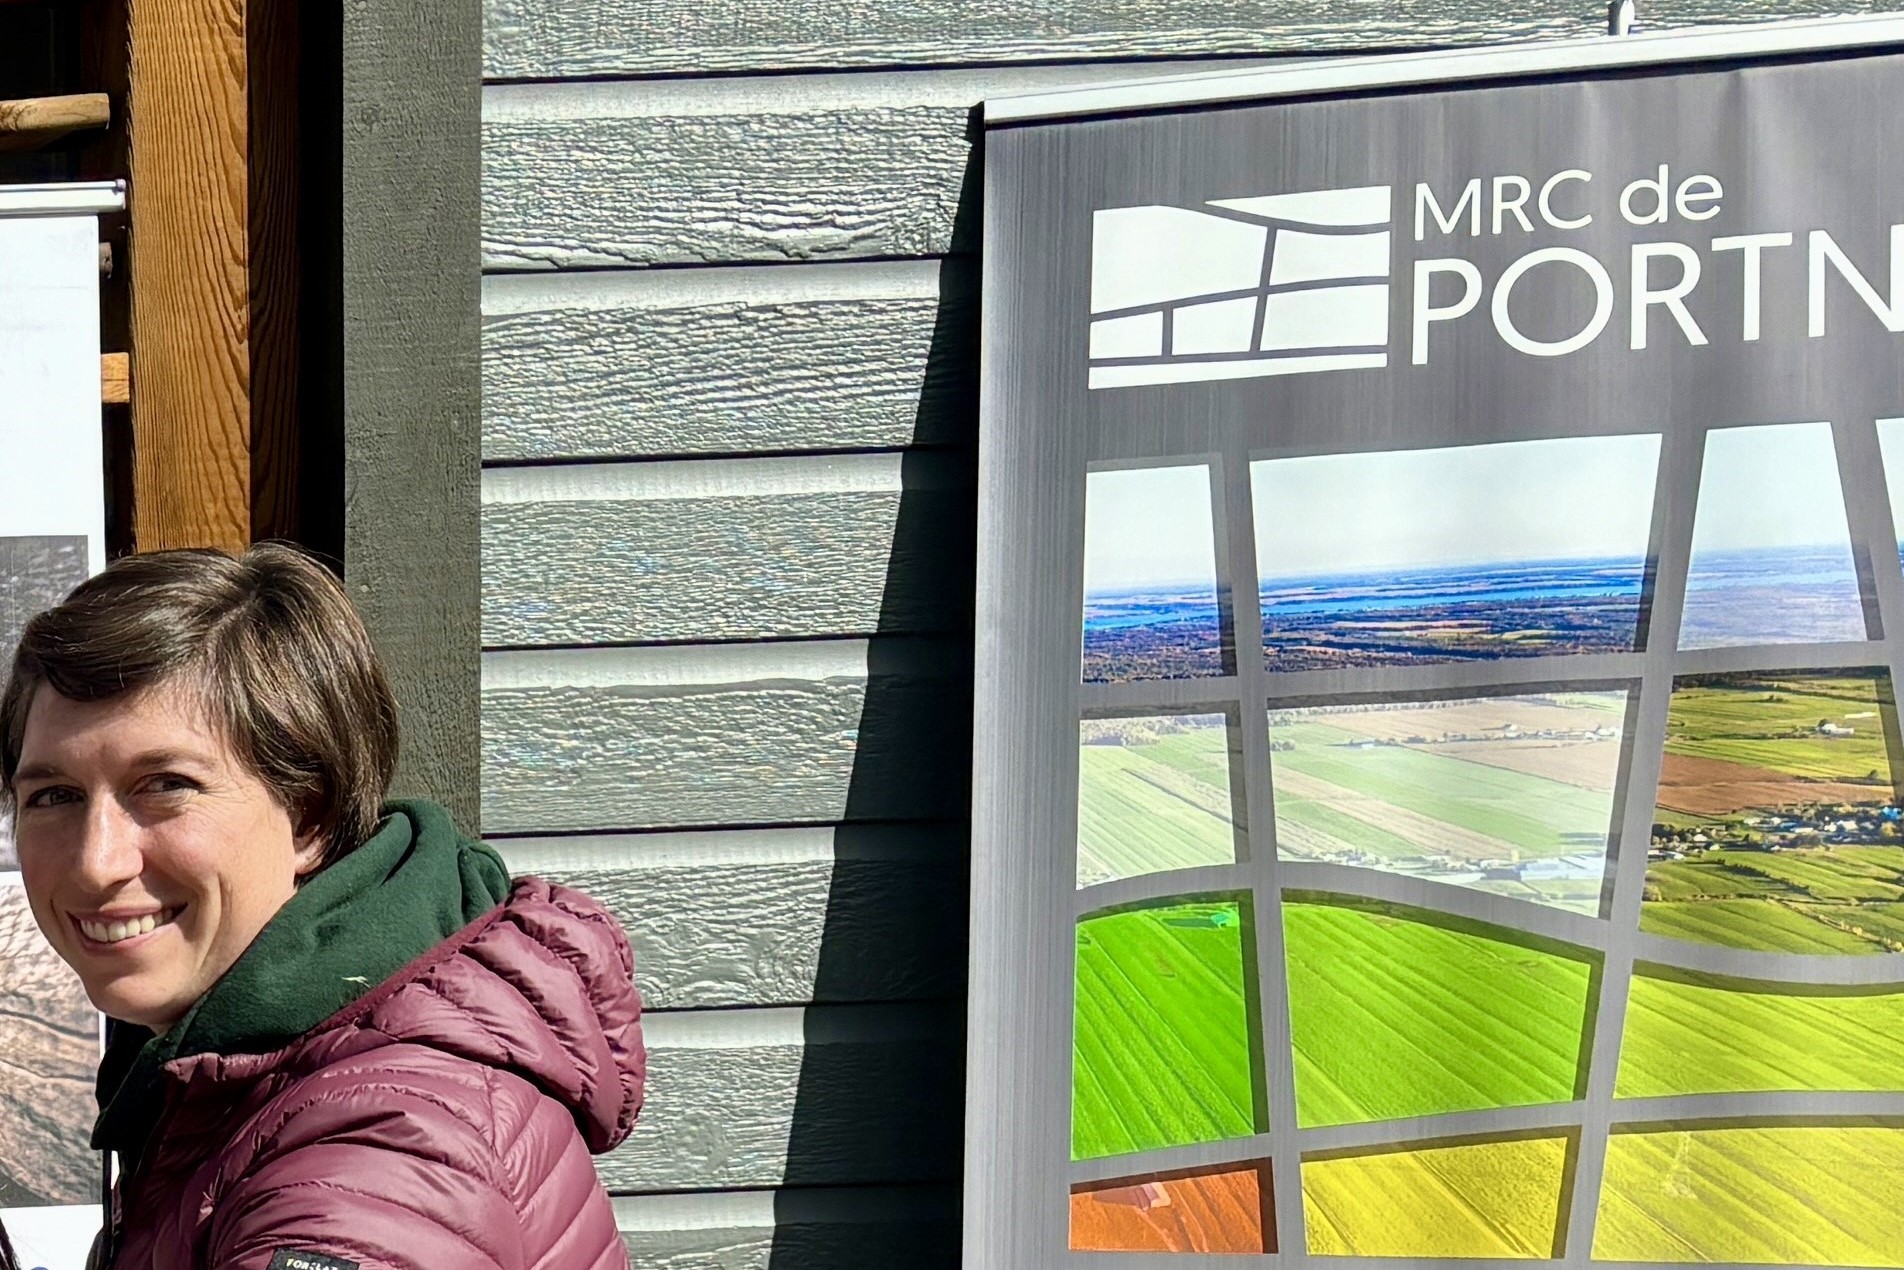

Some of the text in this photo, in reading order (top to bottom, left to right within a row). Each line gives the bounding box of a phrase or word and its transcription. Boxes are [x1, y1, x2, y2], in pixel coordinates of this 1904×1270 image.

[1415, 165, 1722, 240] MRC de
[1413, 224, 1904, 364] PORTN
